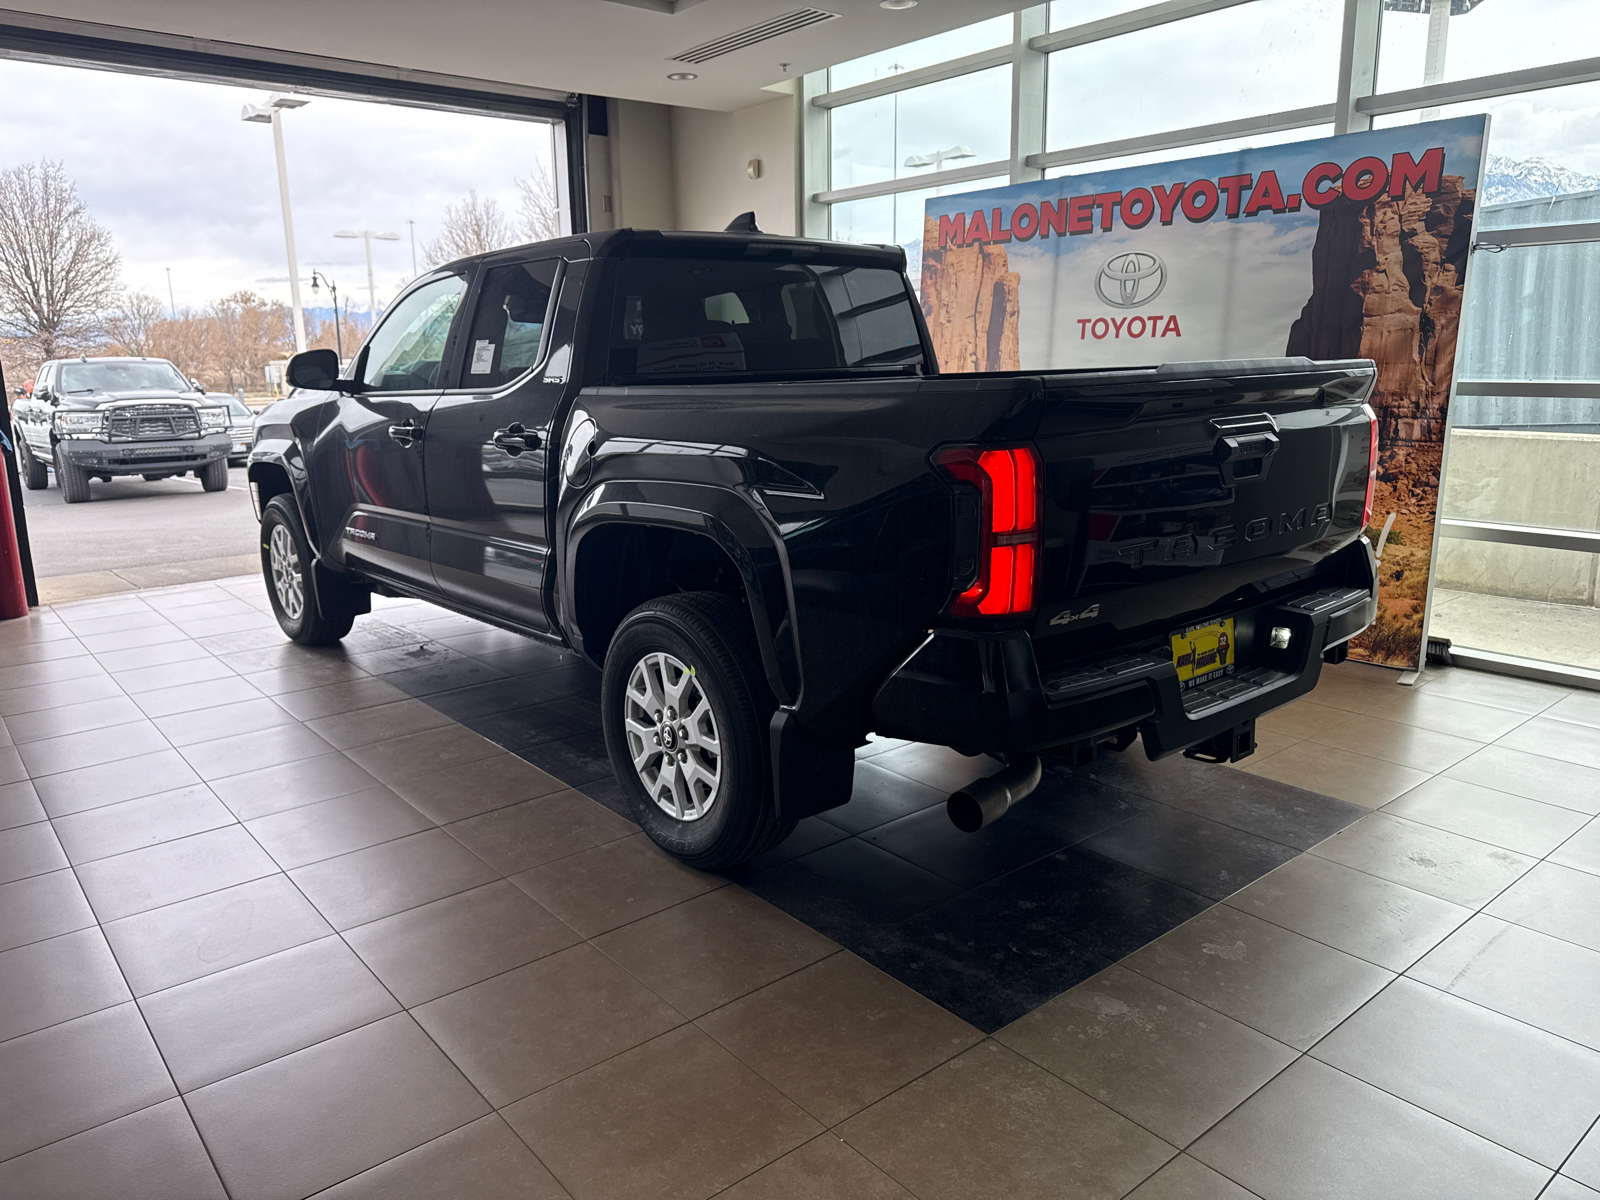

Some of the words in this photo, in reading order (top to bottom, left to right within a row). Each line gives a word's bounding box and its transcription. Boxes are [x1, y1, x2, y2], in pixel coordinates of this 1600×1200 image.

[937, 147, 1446, 249] MALONETOYOTA.COM
[1076, 314, 1182, 340] TOYOTA
[345, 526, 376, 541] TACOMA
[1117, 502, 1332, 569] TACOMA
[1220, 637, 1226, 645] 32
